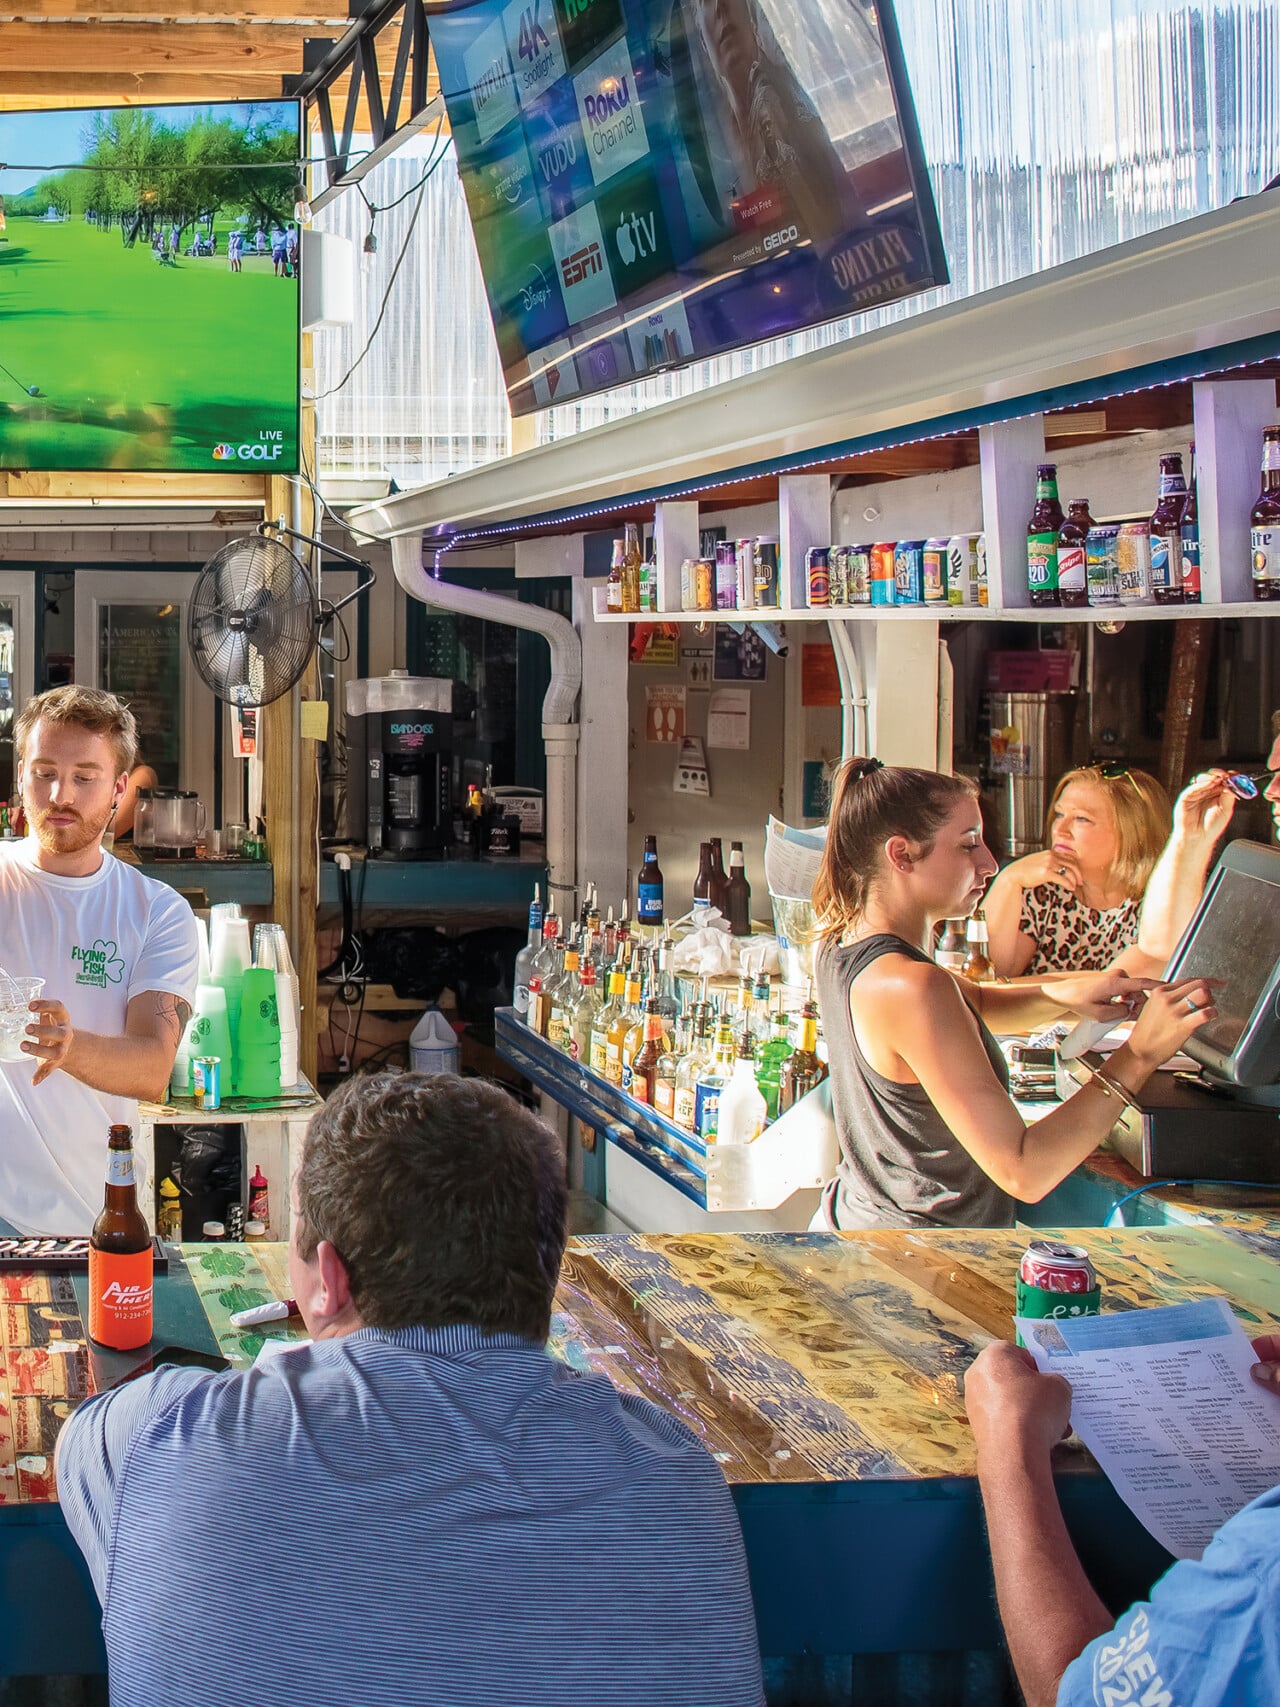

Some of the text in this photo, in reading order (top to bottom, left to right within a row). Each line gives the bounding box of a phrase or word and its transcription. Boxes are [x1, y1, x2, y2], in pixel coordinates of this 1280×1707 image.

[518, 3, 550, 62] 4K
[522, 52, 556, 89] Spotlight
[592, 106, 637, 156] Channel
[539, 134, 577, 182] VUDU
[740, 199, 773, 219] Watch Free
[630, 211, 657, 257] tv
[763, 224, 799, 251] GEICO
[732, 244, 762, 262] Presented by
[561, 242, 603, 288] ESPN
[259, 430, 283, 441] LIVE
[237, 444, 283, 460] GOLF
[1182, 540, 1200, 551] Tir
[71, 945, 107, 963] FLYING
[83, 960, 105, 975] FISH
[101, 1281, 140, 1301] AIR
[115, 1291, 152, 1304] THER
[1100, 1636, 1141, 1707] 202
